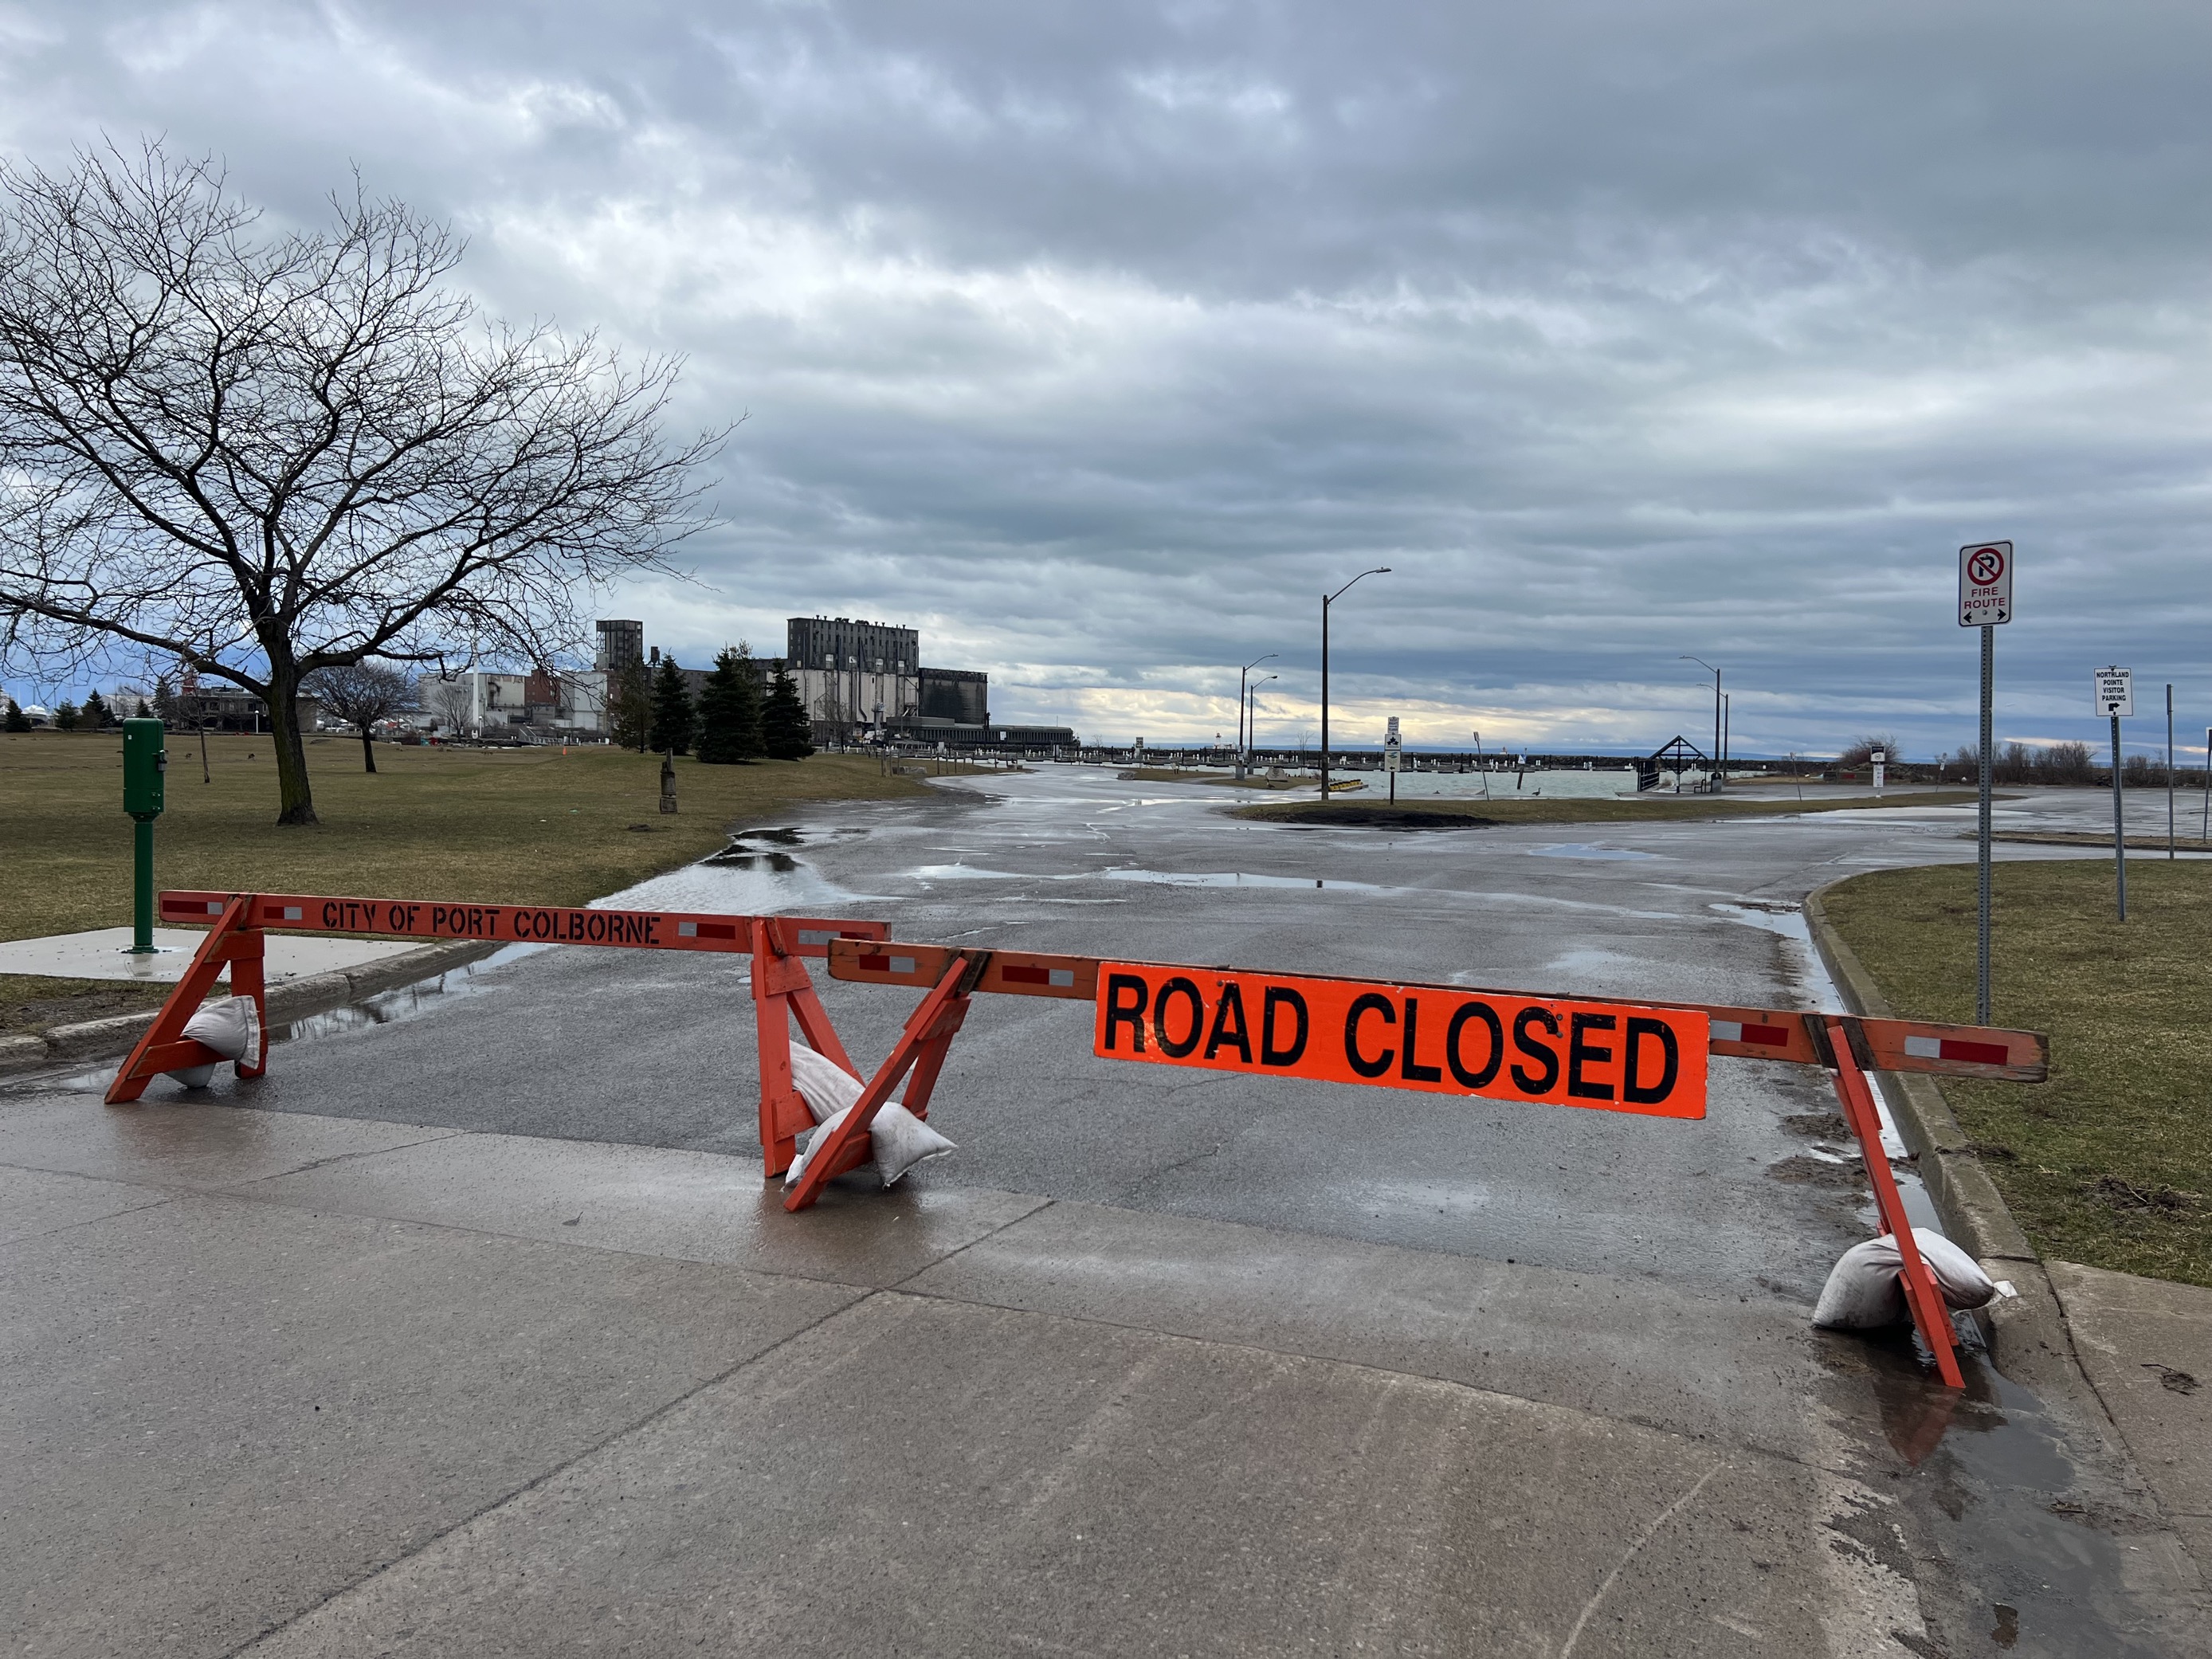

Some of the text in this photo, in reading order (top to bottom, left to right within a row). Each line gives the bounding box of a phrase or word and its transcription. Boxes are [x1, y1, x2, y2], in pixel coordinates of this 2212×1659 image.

[1964, 598, 2006, 610] ROUTE
[1971, 586, 1998, 597] FIRE
[322, 901, 661, 945] CITY OF PORT COLBORNE
[1104, 973, 1679, 1104] ROAD CLOSED
